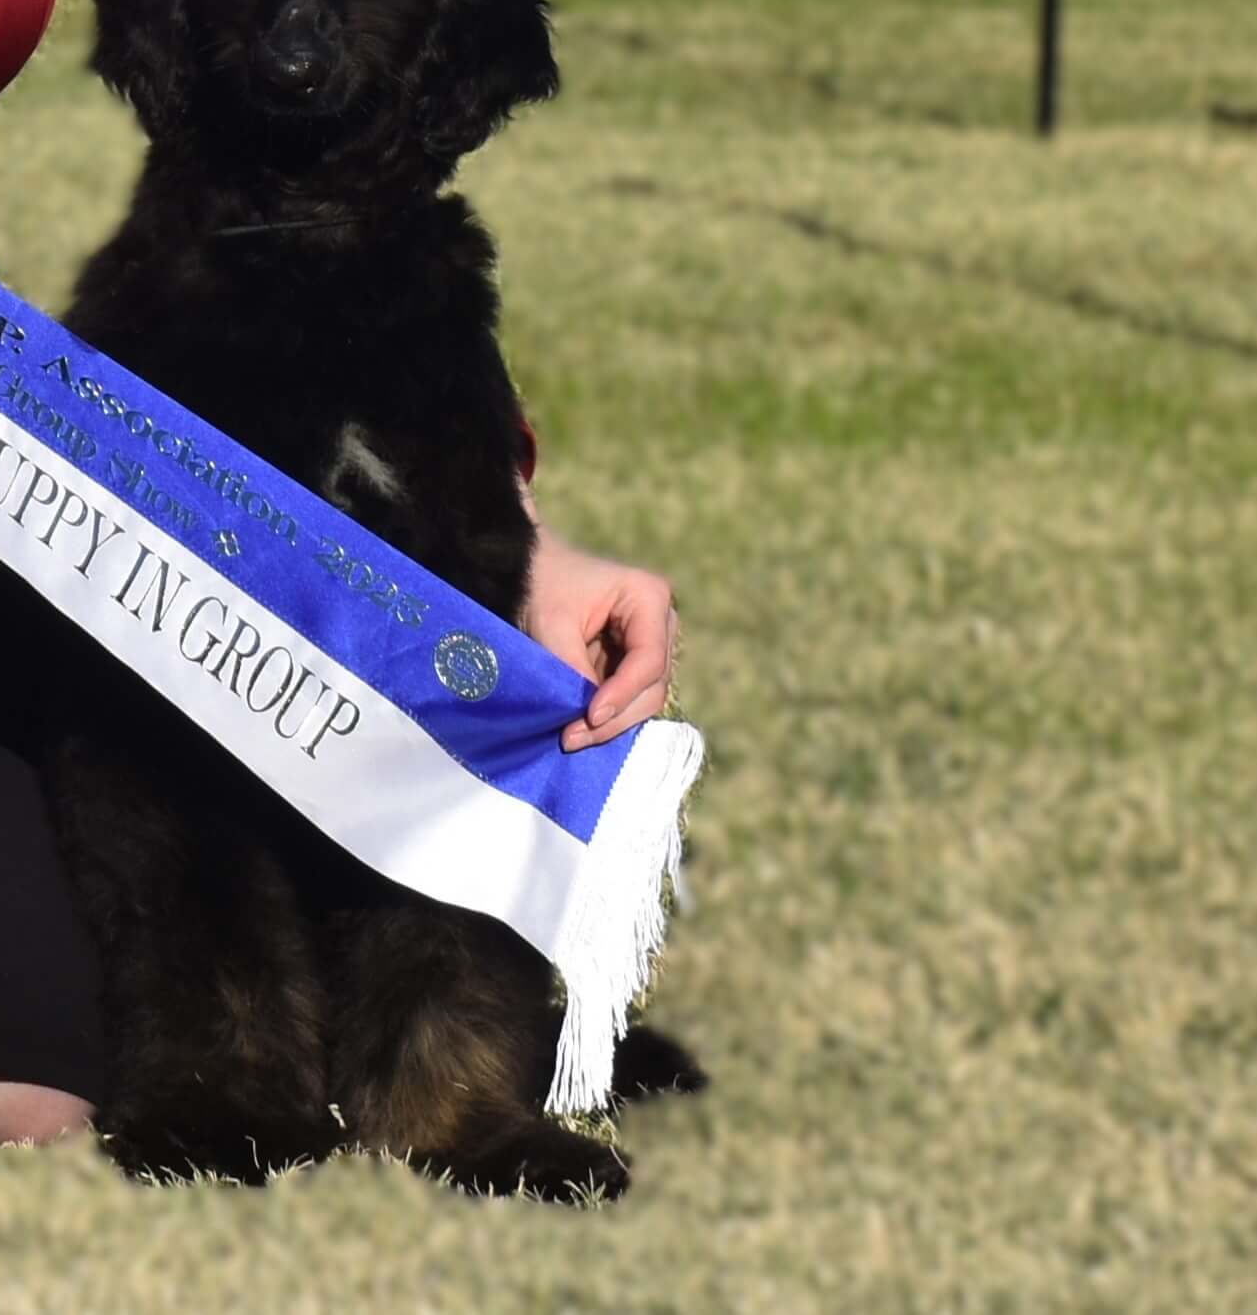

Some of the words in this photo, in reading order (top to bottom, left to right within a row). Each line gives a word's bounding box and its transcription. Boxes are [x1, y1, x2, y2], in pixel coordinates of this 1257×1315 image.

[41, 355, 299, 548] Association
[102, 448, 196, 529] Show
[109, 540, 192, 634] IN
[178, 595, 362, 761] GROUP
